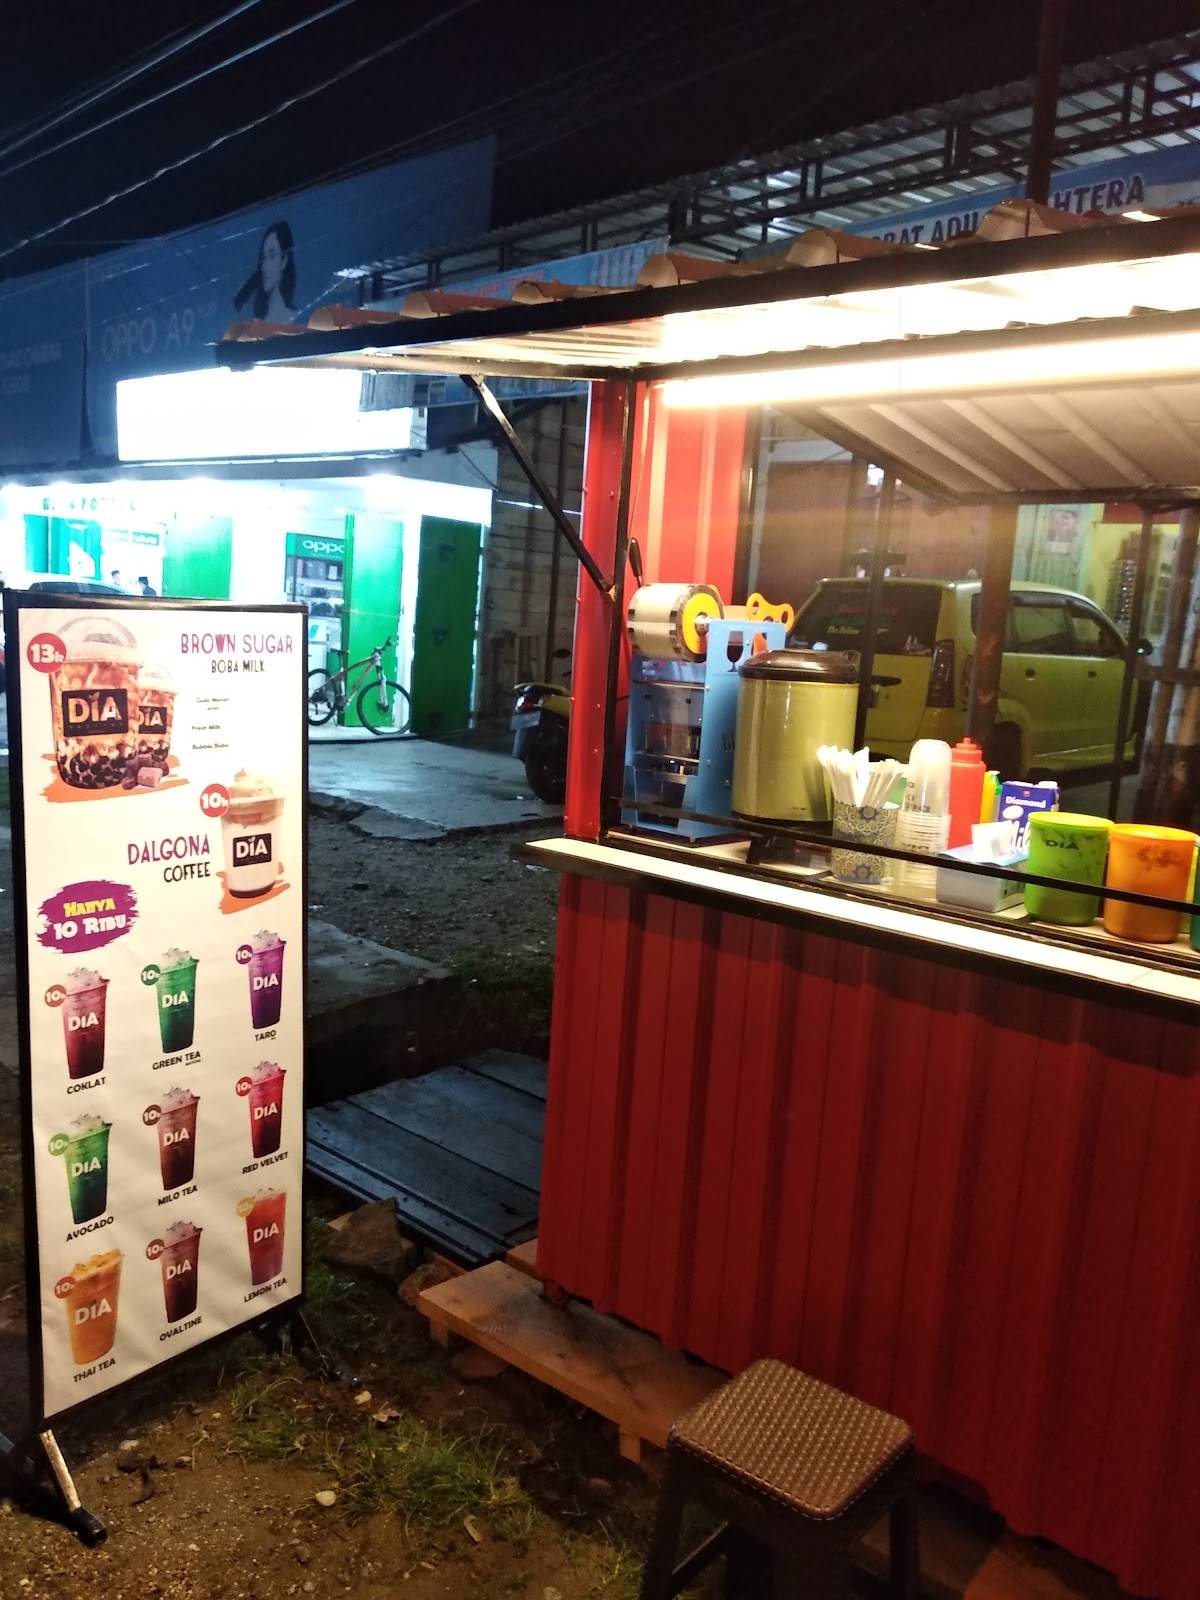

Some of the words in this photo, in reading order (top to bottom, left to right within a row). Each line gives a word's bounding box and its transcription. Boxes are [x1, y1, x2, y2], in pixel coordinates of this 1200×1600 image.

[102, 315, 157, 362] OPPO
[165, 308, 195, 346] A9
[29, 643, 65, 664] 13k
[180, 633, 236, 655] BROWN
[242, 634, 293, 654] SUGAR
[211, 659, 239, 674] BOBA
[242, 659, 265, 673] MILK
[1005, 795, 1047, 809] Diamond
[127, 833, 210, 865] DALGONA
[163, 861, 211, 883] COFFEE
[53, 920, 78, 940] 10
[254, 1029, 277, 1042] TARO
[152, 1055, 183, 1070] GREEN
[184, 1051, 201, 1062] TEA
[66, 1076, 106, 1095] COKLAT
[242, 1162, 259, 1175] RED
[260, 1151, 289, 1169] VELVET
[157, 1192, 180, 1207] MILO
[181, 1184, 198, 1197] TEA
[66, 1216, 114, 1242] AVOCADO
[243, 1285, 272, 1303] LEMON
[273, 1277, 287, 1289] TEA
[159, 1315, 203, 1342] OVALTINE
[73, 1366, 97, 1383] THAI
[98, 1358, 116, 1372] TEA
